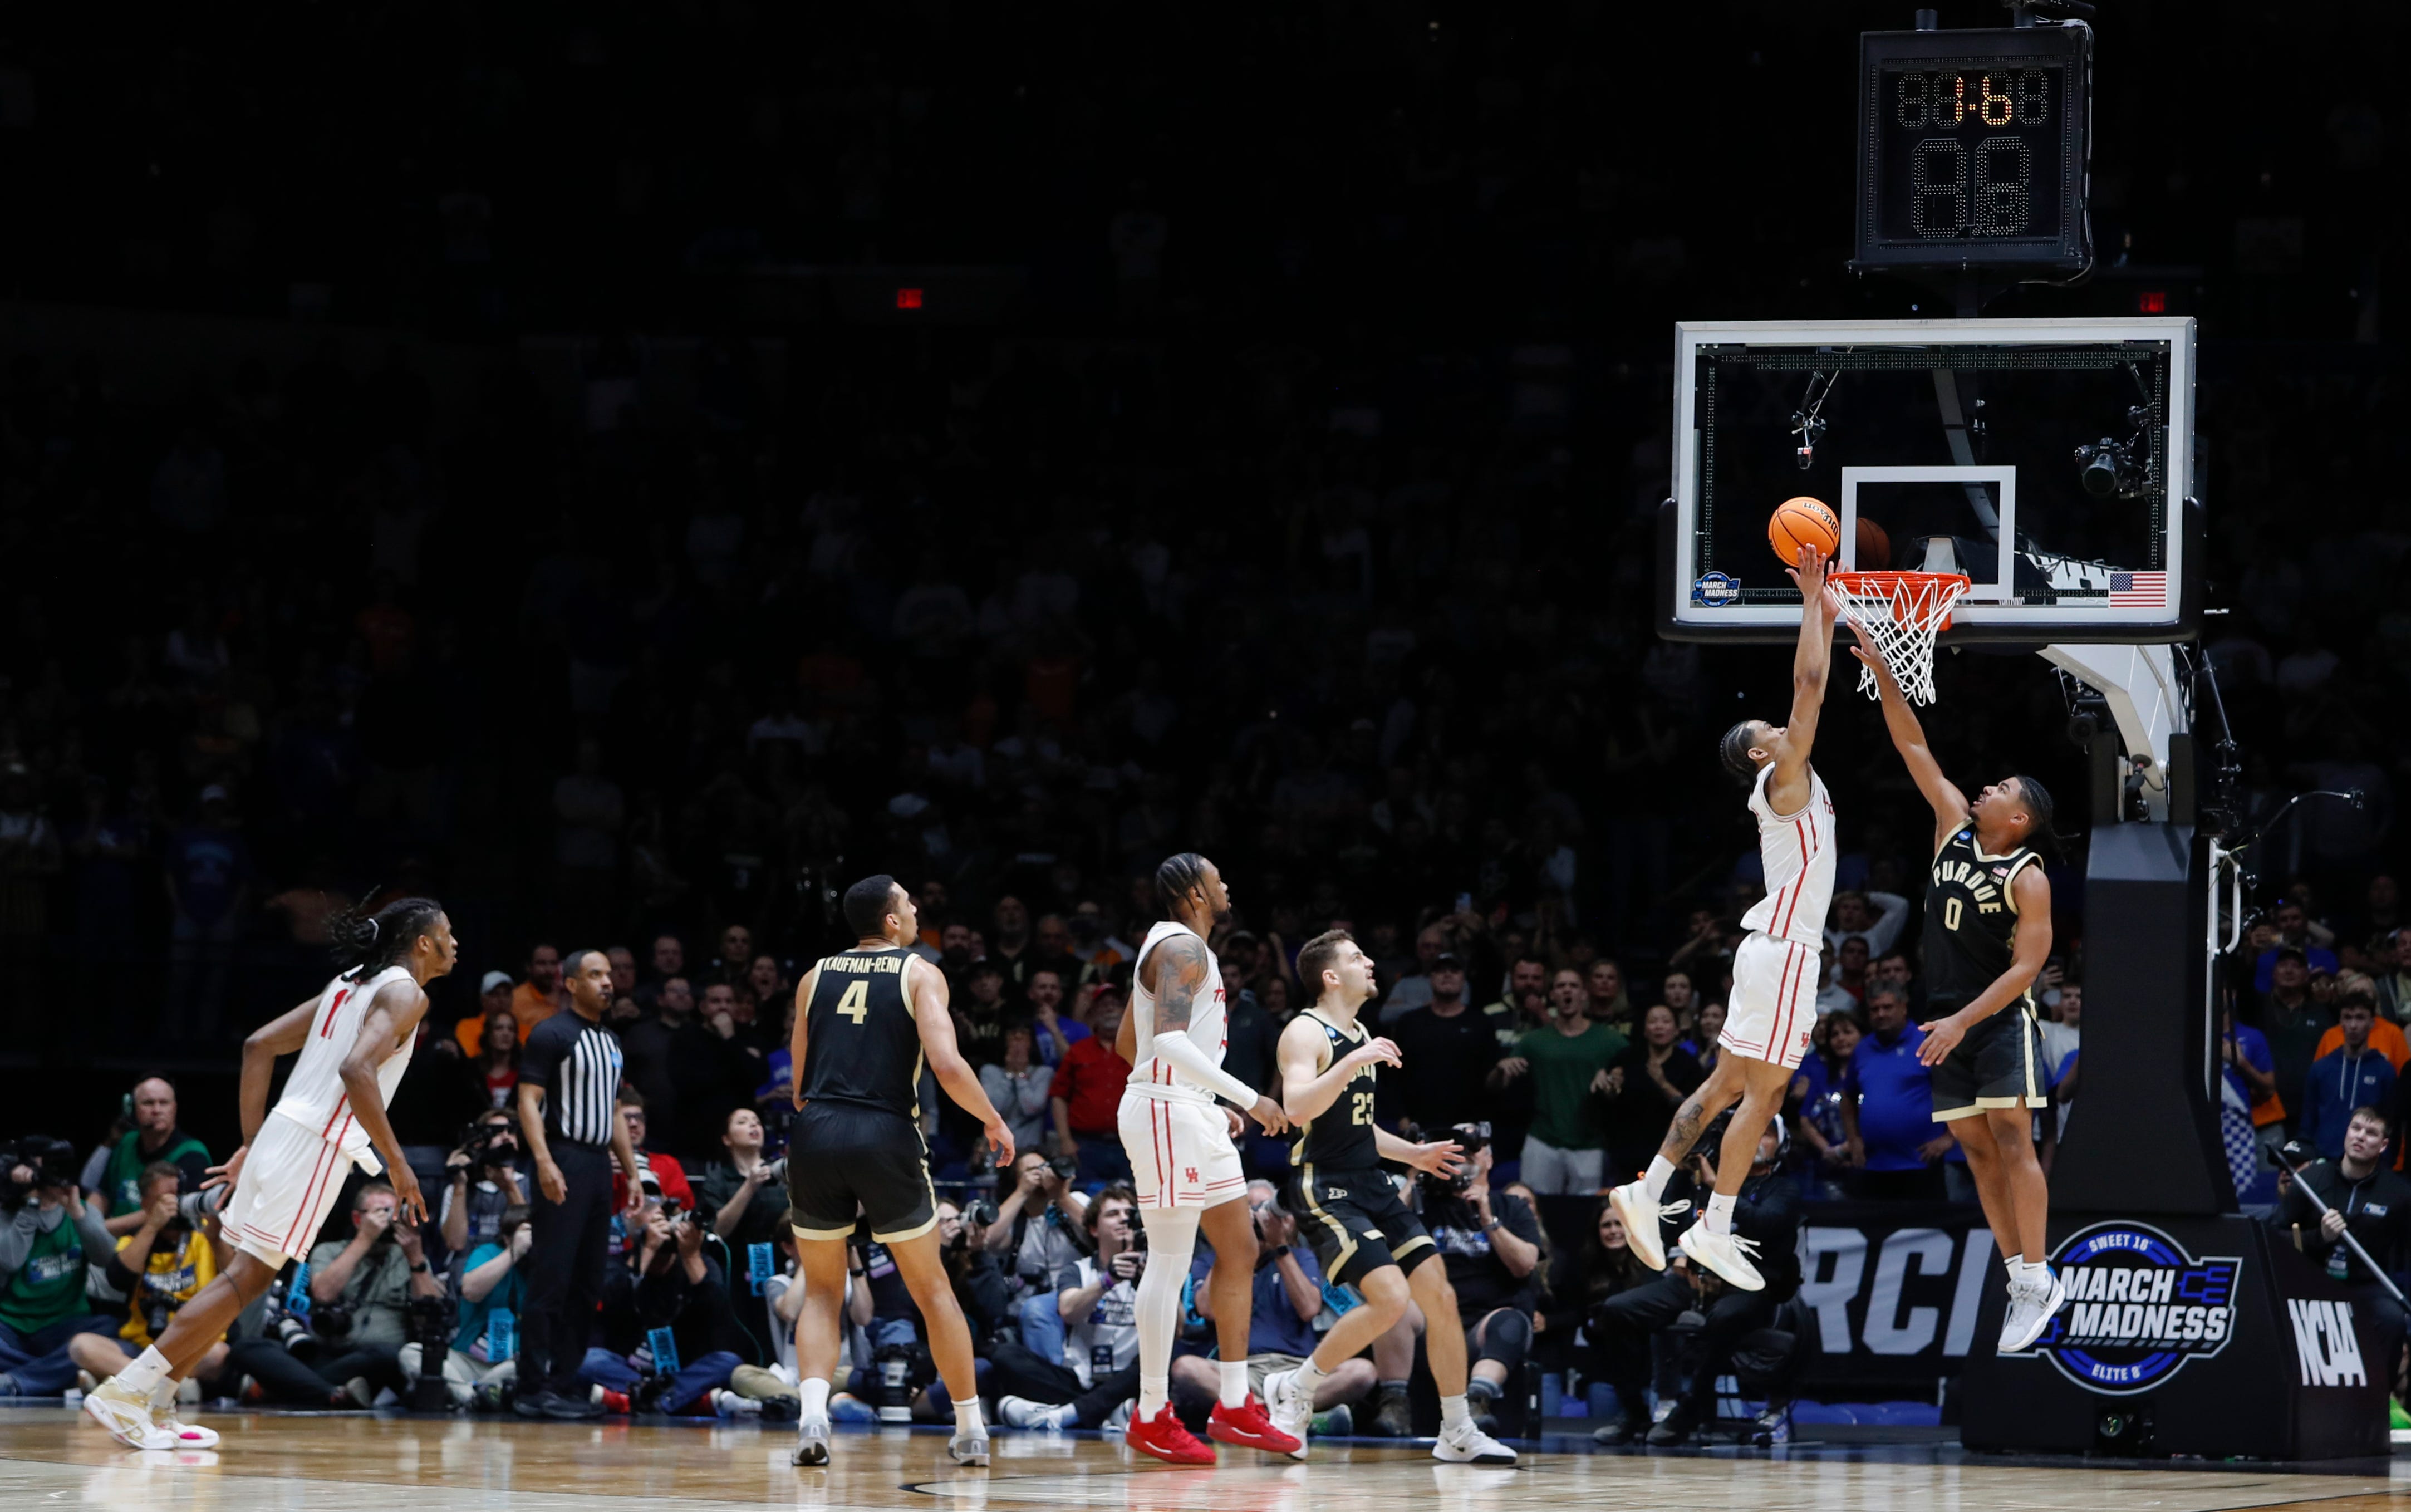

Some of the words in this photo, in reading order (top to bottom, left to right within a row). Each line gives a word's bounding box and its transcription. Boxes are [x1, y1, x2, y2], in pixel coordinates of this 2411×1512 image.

[1933, 860, 2002, 914] PURDUE
[1944, 897, 1963, 931] 0
[823, 956, 902, 974] KAUFMAN-RENN
[836, 980, 869, 1024] 4
[1352, 1092, 1374, 1126] 23
[2089, 1234, 2131, 1253] SWEET
[2133, 1236, 2149, 1251] 16
[2060, 1266, 2176, 1303] MARCH
[2069, 1302, 2228, 1341] MADNESS
[2287, 1298, 2368, 1387] NCAA
[2091, 1363, 2128, 1381] ELITE
[2131, 1366, 2142, 1380] 8
